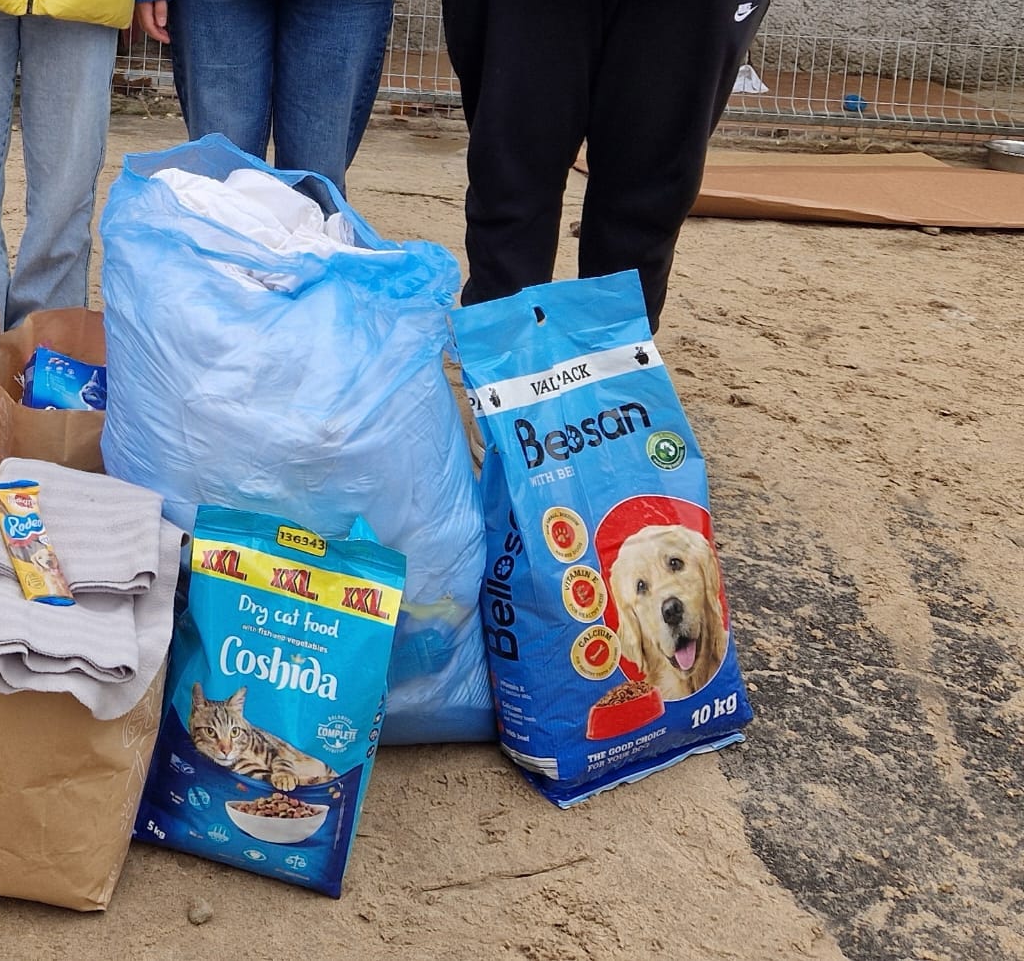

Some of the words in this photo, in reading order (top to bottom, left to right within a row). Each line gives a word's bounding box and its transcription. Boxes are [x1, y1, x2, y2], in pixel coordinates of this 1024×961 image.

[8, 516, 42, 537] Rodeo
[279, 531, 325, 550] 136343
[201, 549, 247, 581] XXL
[270, 567, 319, 601] XXL
[341, 587, 390, 620] XXL
[565, 569, 591, 590] VITAMIN
[239, 594, 269, 626] Dry
[274, 608, 300, 626] cat
[304, 611, 340, 638] food
[578, 629, 613, 648] CALCIUM
[219, 635, 338, 701] Coshida
[691, 704, 712, 729] 10
[712, 692, 738, 719] kg
[317, 726, 357, 741] COMPLETE
[587, 751, 606, 763] THE
[608, 740, 634, 756] GOOD
[635, 727, 667, 747] CHOICE
[587, 761, 605, 772] FOR
[146, 820, 154, 831] 5
[154, 825, 166, 839] kg
